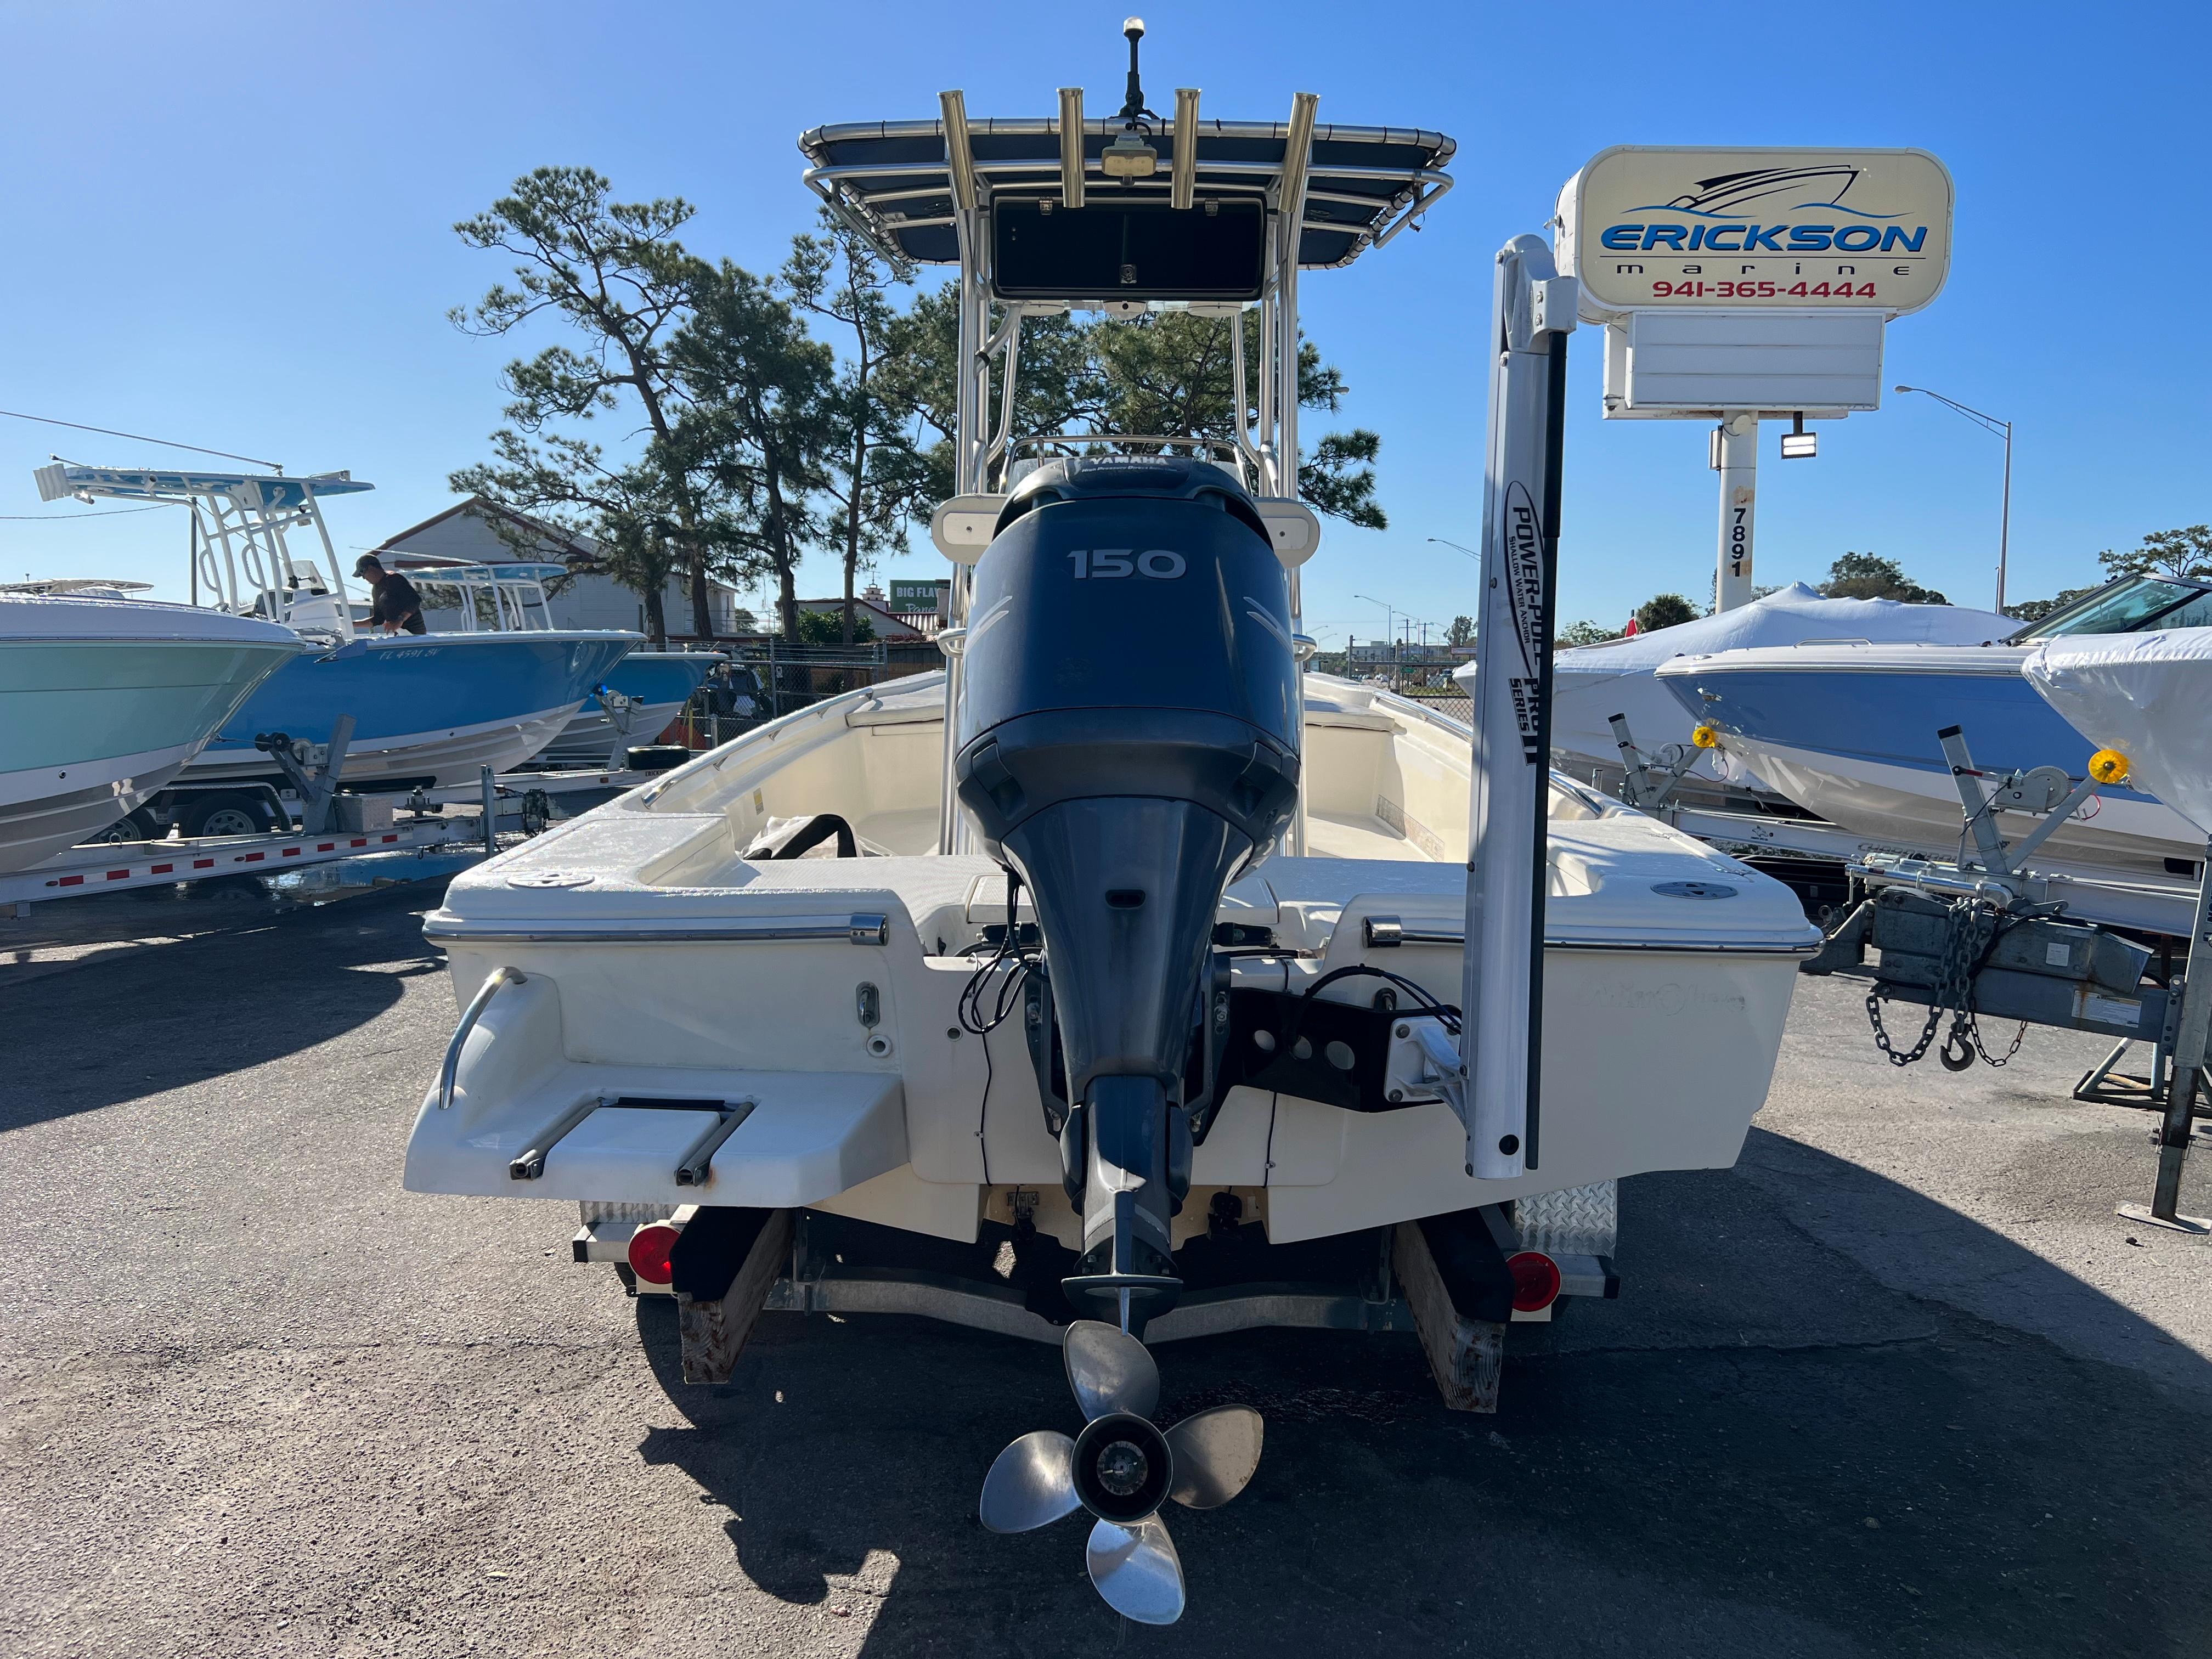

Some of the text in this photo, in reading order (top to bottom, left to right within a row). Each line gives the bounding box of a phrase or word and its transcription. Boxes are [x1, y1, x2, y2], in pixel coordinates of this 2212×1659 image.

[1600, 224, 1928, 251] ERICKSON
[1616, 262, 1910, 275] marine
[1652, 281, 1877, 298] 941-365-4444
[1089, 456, 1169, 466] YAMAHA
[1731, 508, 1746, 577] 7891
[1066, 549, 1187, 579] 150
[896, 587, 914, 597] BIG
[1509, 535, 1530, 644] SHALLOW WATER ANCHOR
[379, 651, 393, 661] FL
[1510, 678, 1530, 732] SERIES
